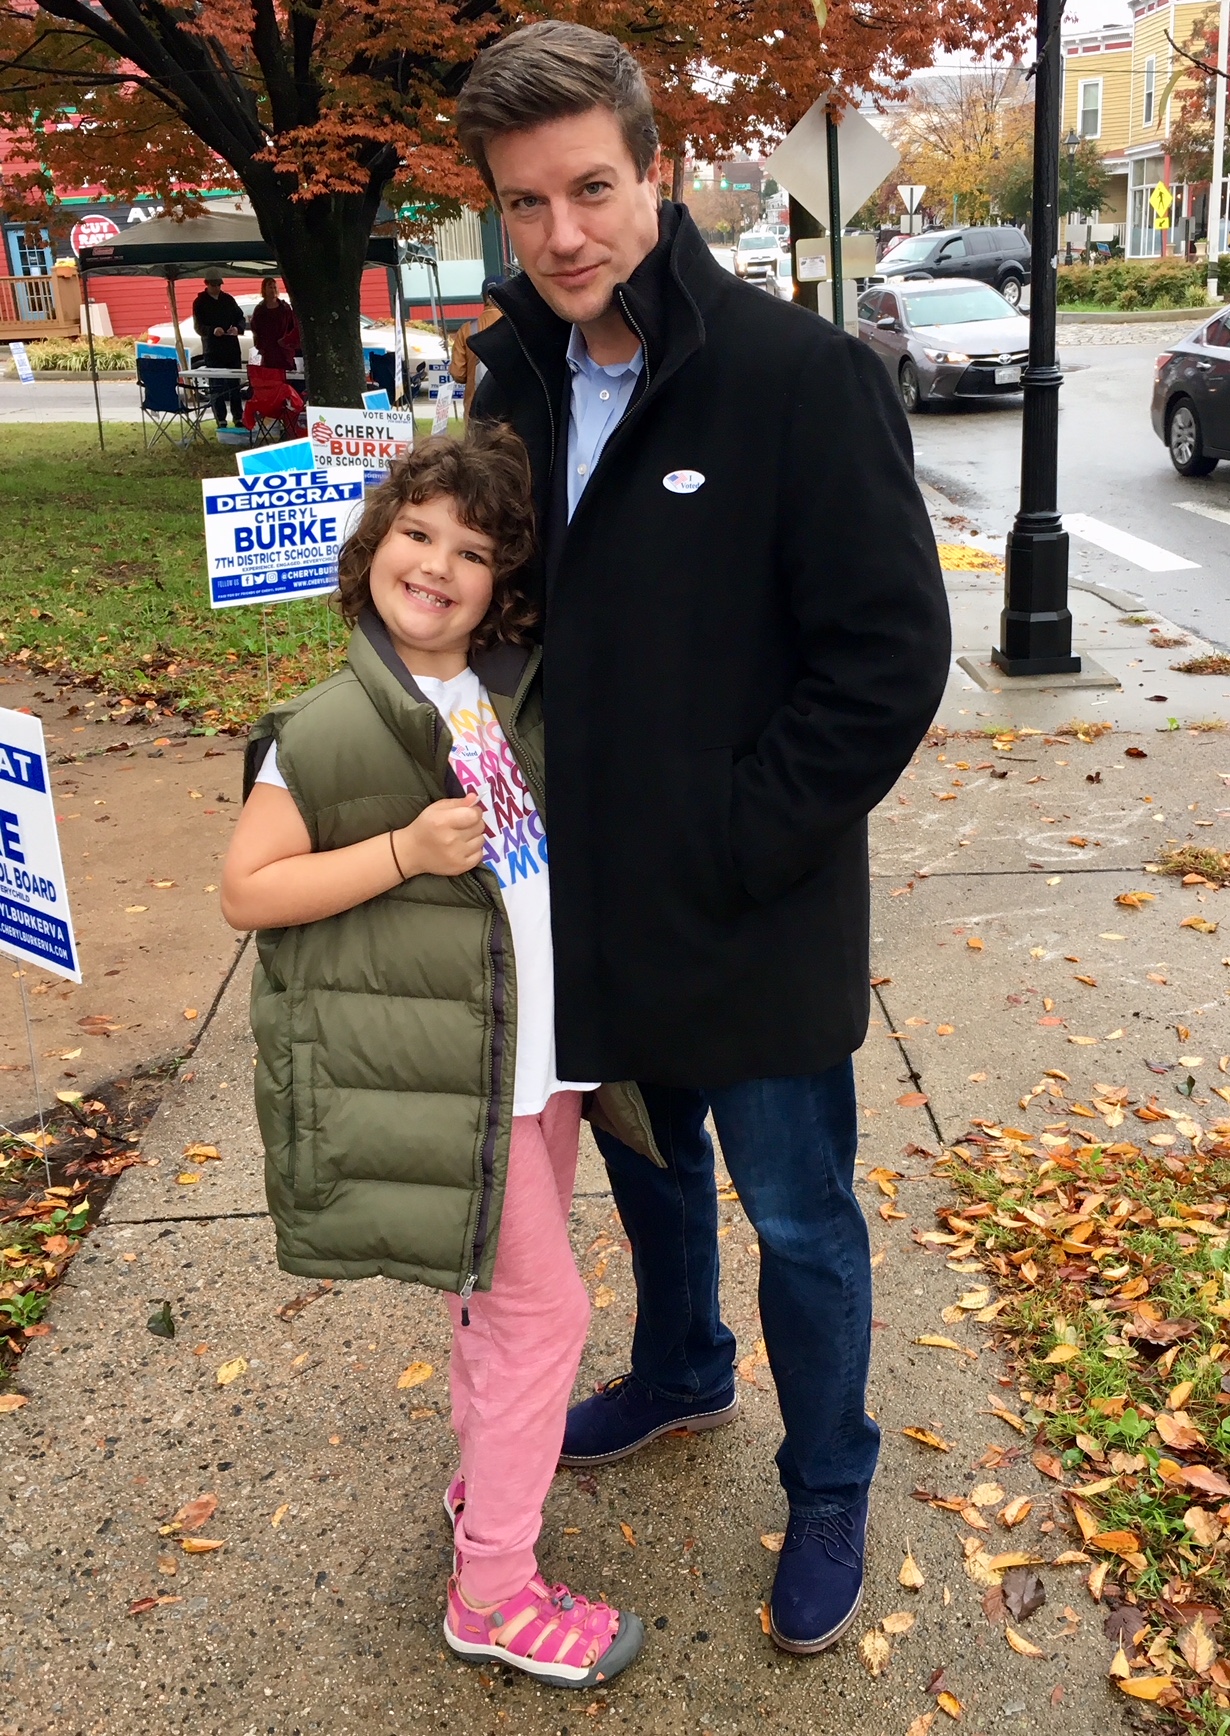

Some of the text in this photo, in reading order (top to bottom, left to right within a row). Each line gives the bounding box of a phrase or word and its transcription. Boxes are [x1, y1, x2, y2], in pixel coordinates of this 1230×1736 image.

[80, 222, 110, 233] CUT
[363, 411, 384, 420] VOTE
[334, 424, 394, 440] CHERYL
[330, 440, 407, 458] BURKE
[314, 455, 332, 466] FOR
[336, 456, 375, 468] SCHOOL
[238, 470, 329, 492] VOTE
[216, 484, 354, 512] DEMOCRAT
[254, 507, 318, 524] CHERYL
[235, 517, 337, 553] BURKE
[214, 556, 235, 569] 7TH
[237, 551, 281, 567] DISTRICT
[284, 546, 323, 561] SCHOOL
[217, 579, 233, 588] FOLLOW
[0, 884, 30, 902] ERYCHILD
[13, 867, 56, 902] BOARD
